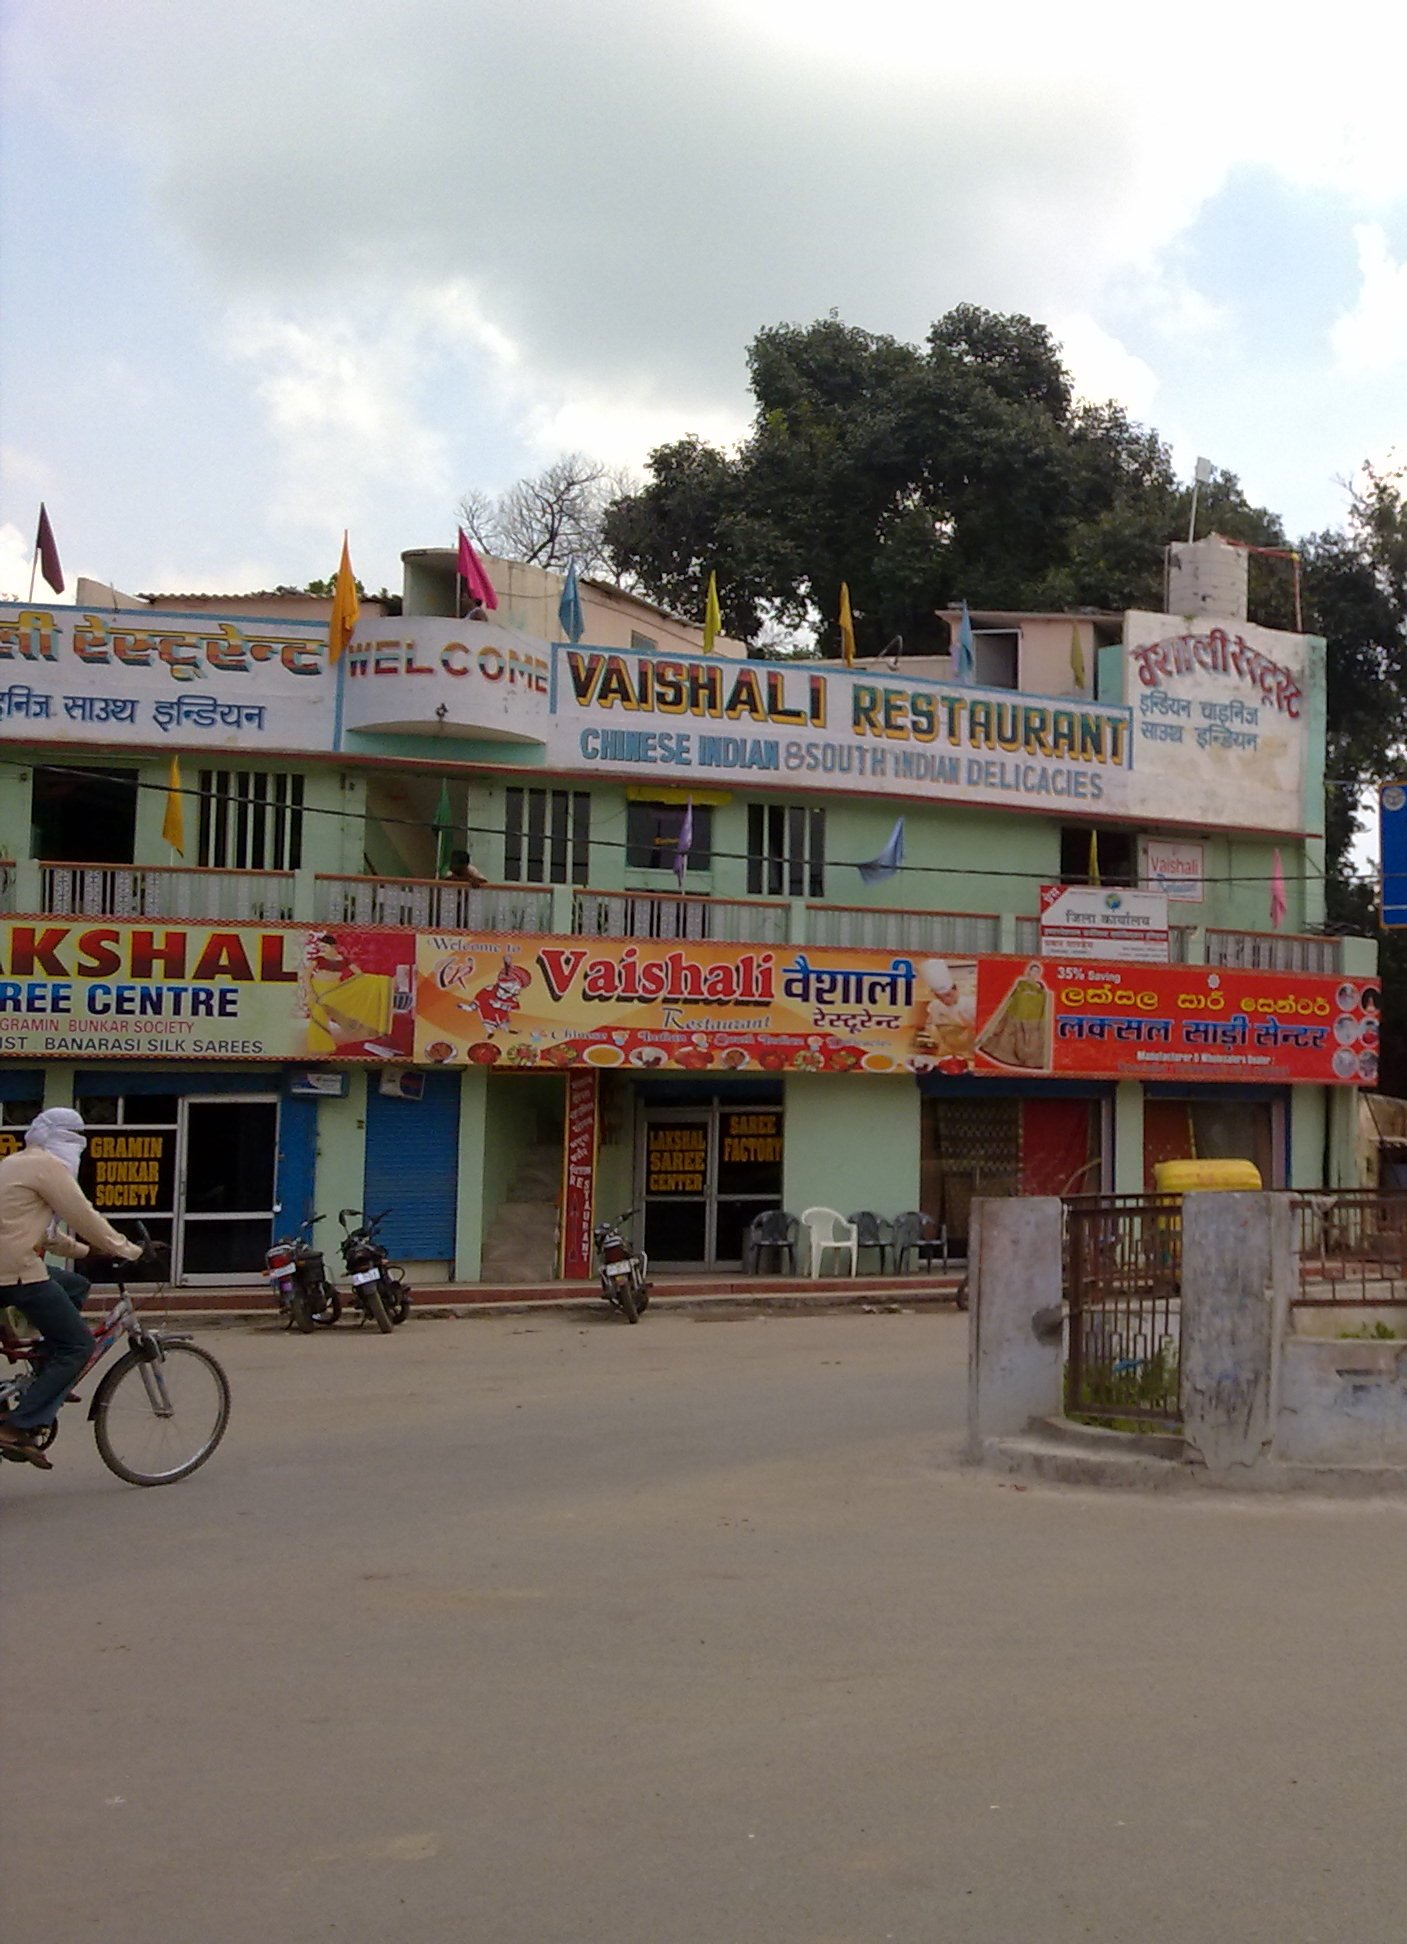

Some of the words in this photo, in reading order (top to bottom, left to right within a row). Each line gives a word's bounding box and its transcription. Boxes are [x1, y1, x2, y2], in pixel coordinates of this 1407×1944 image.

[349, 640, 548, 694] WELCOME
[63, 695, 139, 724] साउथ
[566, 651, 827, 728] VAISHALI
[852, 682, 1129, 766] RESTAURANT
[580, 727, 693, 766] CHINESE
[698, 734, 779, 772] INDIAN
[805, 742, 886, 777] SOUTH
[893, 749, 960, 786] INDIAN
[967, 758, 1104, 800] DELICACIES
[1152, 857, 1199, 875] Vaishali
[0, 926, 298, 983] KSHAL
[427, 937, 500, 953] Welcome
[537, 947, 775, 1006] Vaishali
[1057, 966, 1085, 980] 35%
[87, 984, 239, 1017] CENTRE
[1, 1018, 59, 1032] GRAMIN
[68, 1019, 128, 1033] BUNKAR
[134, 1020, 195, 1034] SOCIETY
[662, 1007, 770, 1031] Restaurant
[45, 1037, 140, 1051] BANARASI
[148, 1039, 186, 1053] SILK
[192, 1040, 263, 1054] SAREES
[91, 1137, 163, 1158] GRAMIN
[96, 1161, 159, 1182] BUNKAR
[650, 1151, 705, 1171] SAREE
[95, 1184, 159, 1206] SOCIETY
